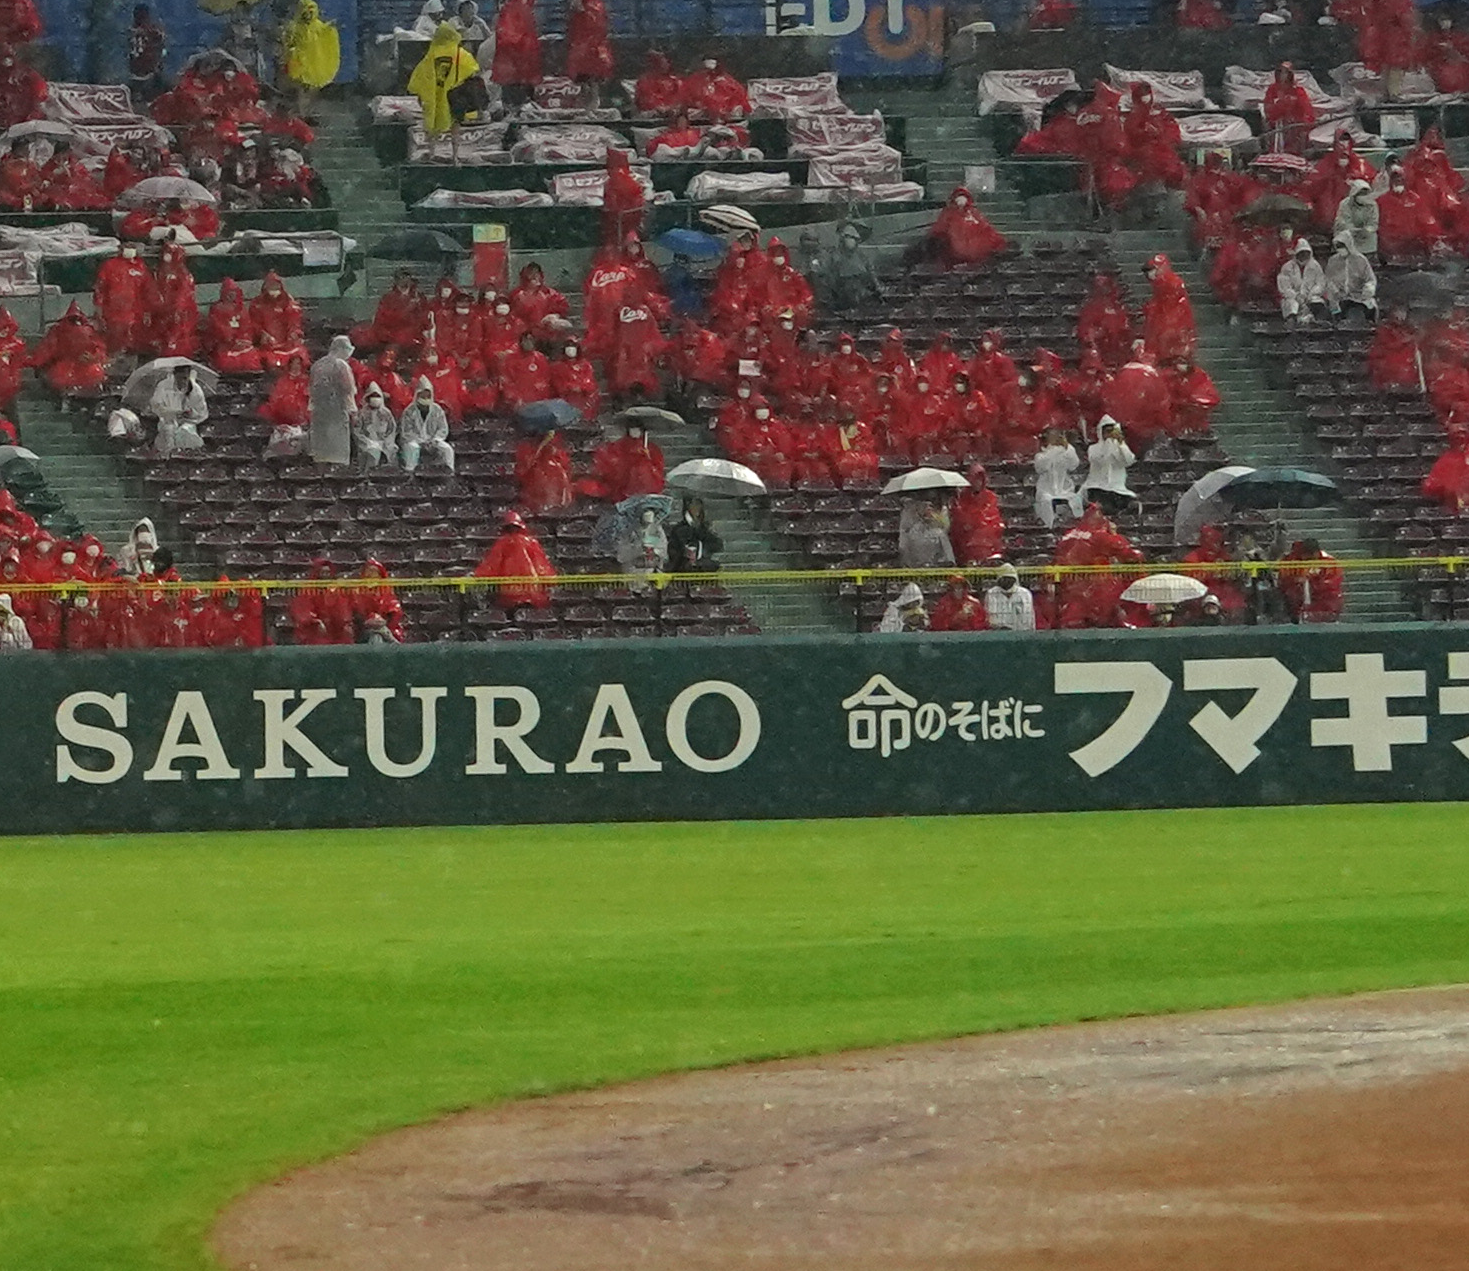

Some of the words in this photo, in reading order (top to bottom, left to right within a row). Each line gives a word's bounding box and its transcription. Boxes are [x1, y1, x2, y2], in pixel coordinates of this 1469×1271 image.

[56, 680, 762, 784] SAKURAO
[842, 674, 1045, 758] 命のそばに
